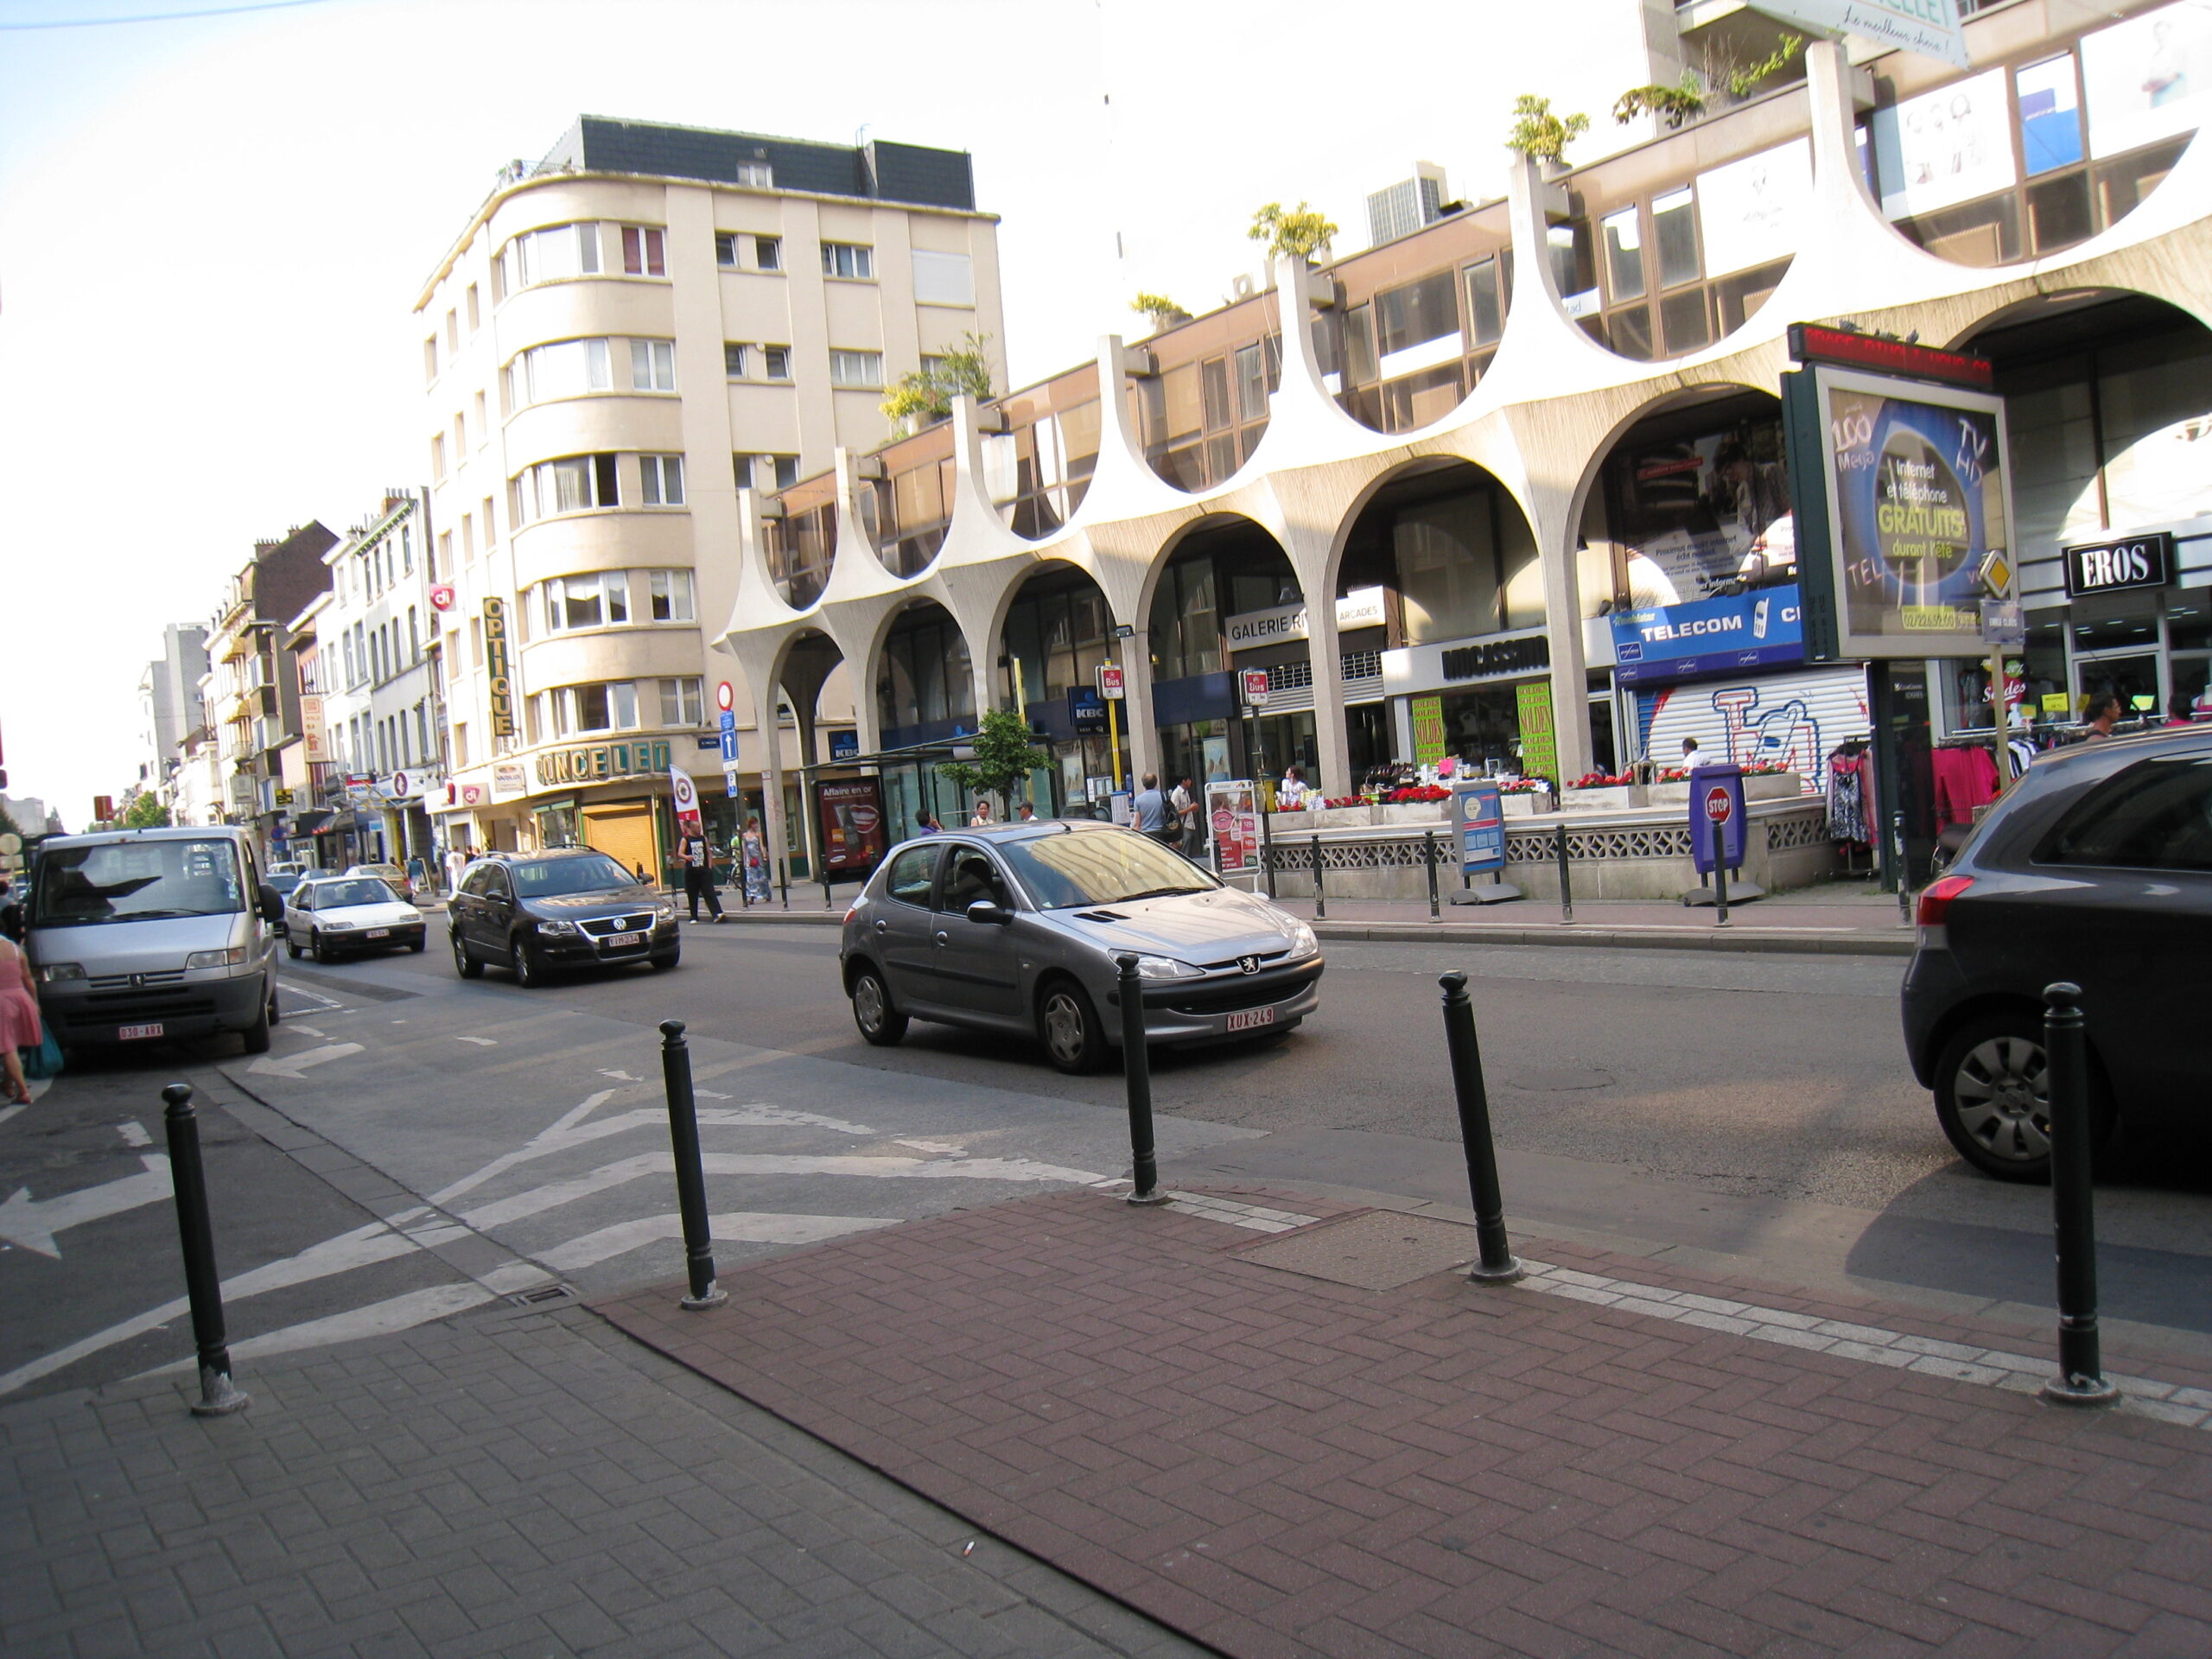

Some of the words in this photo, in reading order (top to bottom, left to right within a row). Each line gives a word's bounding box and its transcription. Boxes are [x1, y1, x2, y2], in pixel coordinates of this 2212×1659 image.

[1831, 414, 1872, 452] 100
[1958, 417, 1987, 460] TV
[1837, 449, 1875, 472] Mega
[1897, 459, 1935, 480] Internet
[1899, 481, 1948, 505] téléphone
[1892, 539, 1926, 557] durant
[2080, 544, 2149, 588] EROS
[435, 589, 450, 605] di
[1231, 616, 1288, 640] GALERIE
[1340, 606, 1377, 621] ARCADES
[1641, 614, 1743, 643] TELECOM
[485, 599, 513, 734] OPTIQUE
[1106, 677, 1120, 686] Bus
[1249, 683, 1264, 691] Bus
[1982, 680, 2026, 702] Sdes
[1076, 709, 1104, 719] KBC
[1521, 705, 1552, 735] SOLDEN
[1416, 718, 1442, 746] SOLDES
[836, 748, 859, 758] KBC
[465, 787, 480, 800] di
[823, 787, 849, 796] Affaire
[1708, 798, 1728, 813] STOP
